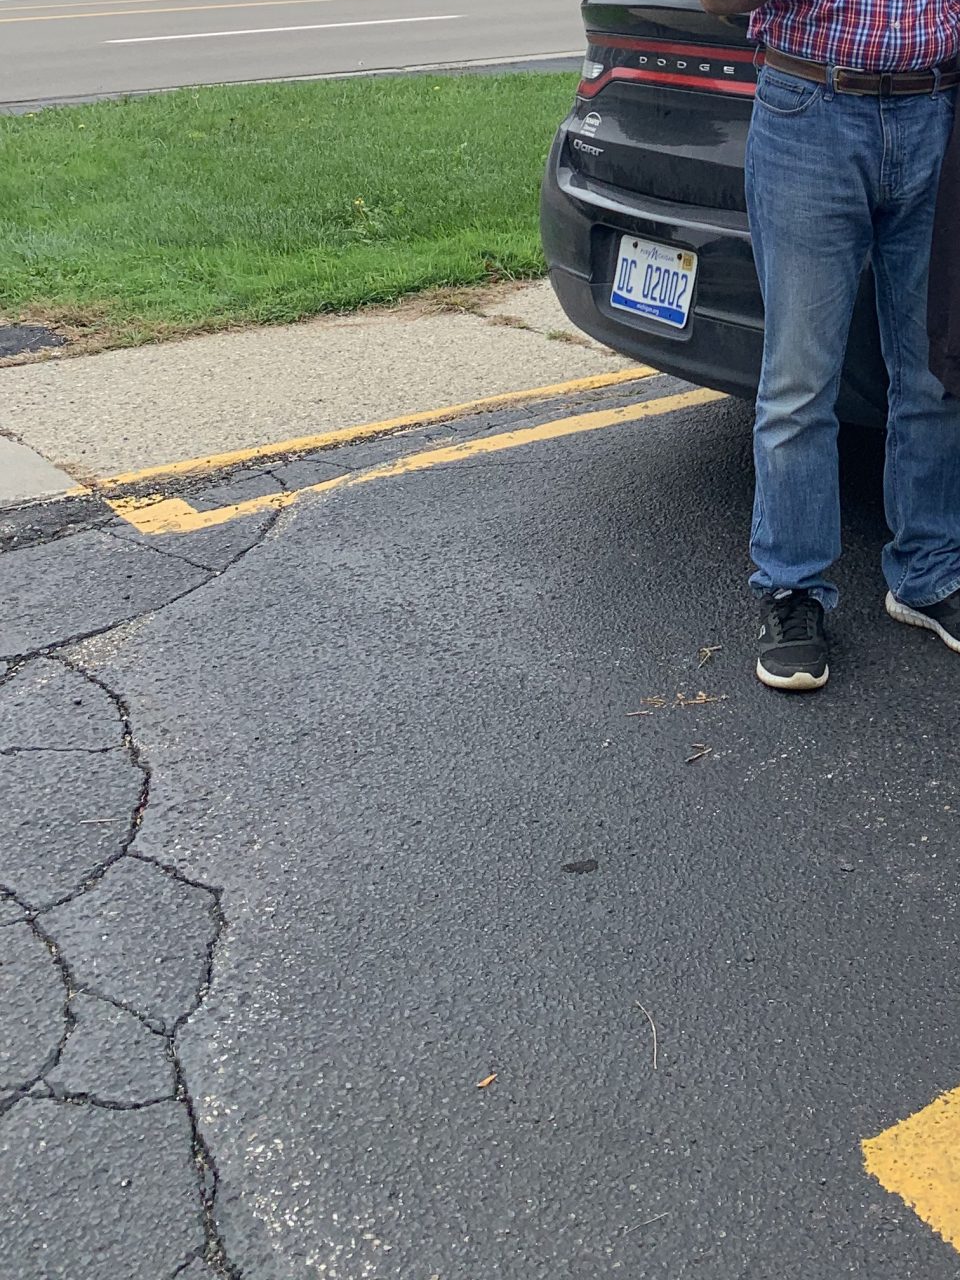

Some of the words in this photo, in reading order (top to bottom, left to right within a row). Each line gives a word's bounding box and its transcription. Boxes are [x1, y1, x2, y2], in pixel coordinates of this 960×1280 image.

[639, 56, 735, 75] DODGE
[617, 257, 637, 294] DC
[642, 263, 689, 310] 02002
